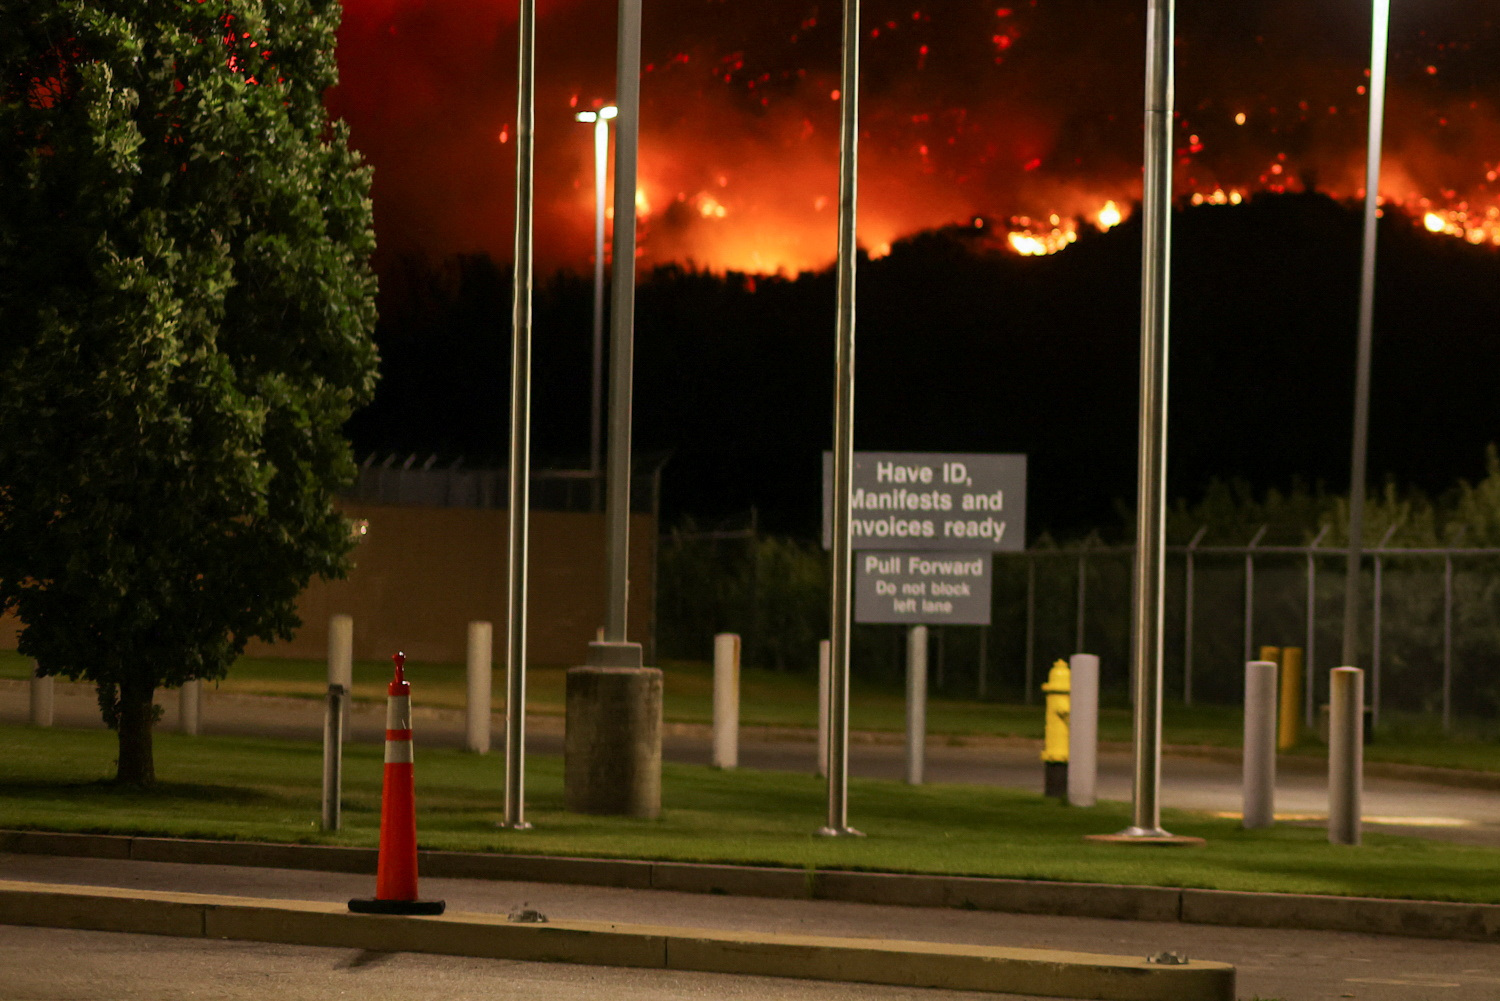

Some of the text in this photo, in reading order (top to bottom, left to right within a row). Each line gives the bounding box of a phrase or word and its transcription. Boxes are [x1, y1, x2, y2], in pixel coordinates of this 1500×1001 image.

[876, 461, 973, 486] Have ID,
[962, 490, 1003, 511] and
[851, 516, 1006, 542] nvoices ready
[865, 556, 983, 576] Pull Forward
[876, 580, 970, 596] Do not block
[893, 599, 952, 613] left lane
